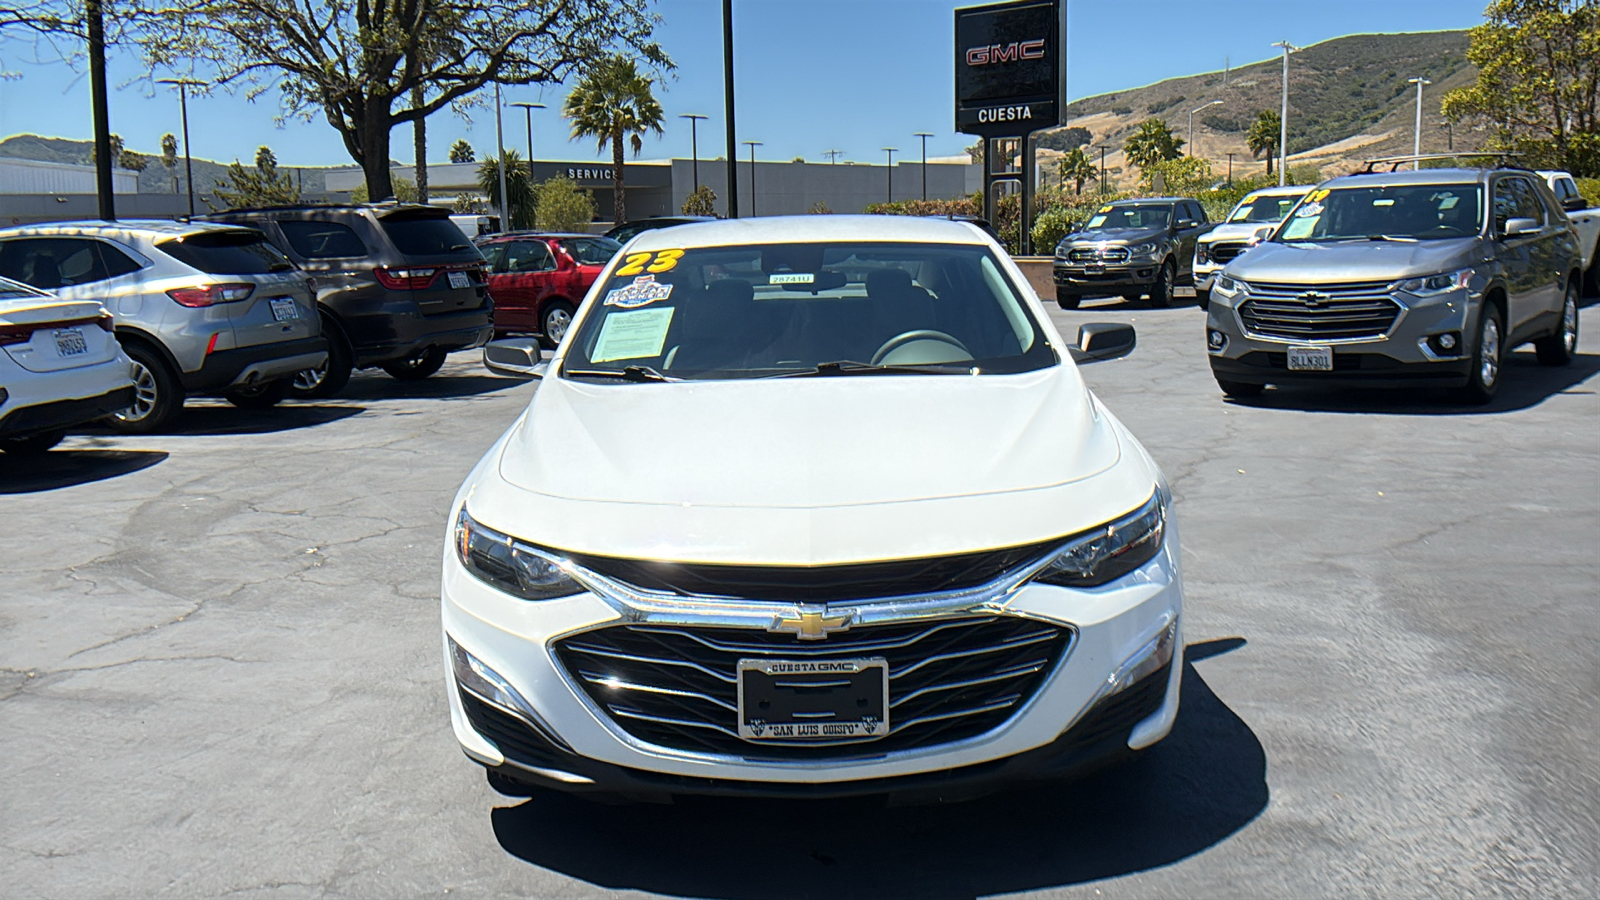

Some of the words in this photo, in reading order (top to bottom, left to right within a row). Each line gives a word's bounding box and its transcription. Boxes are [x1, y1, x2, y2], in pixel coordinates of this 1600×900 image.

[966, 39, 1044, 66] GMC
[978, 105, 1032, 123] CUESTA
[615, 249, 685, 276] 23
[771, 663, 816, 672] CUESTA
[817, 662, 856, 671] GMC
[797, 725, 819, 736] LUIS
